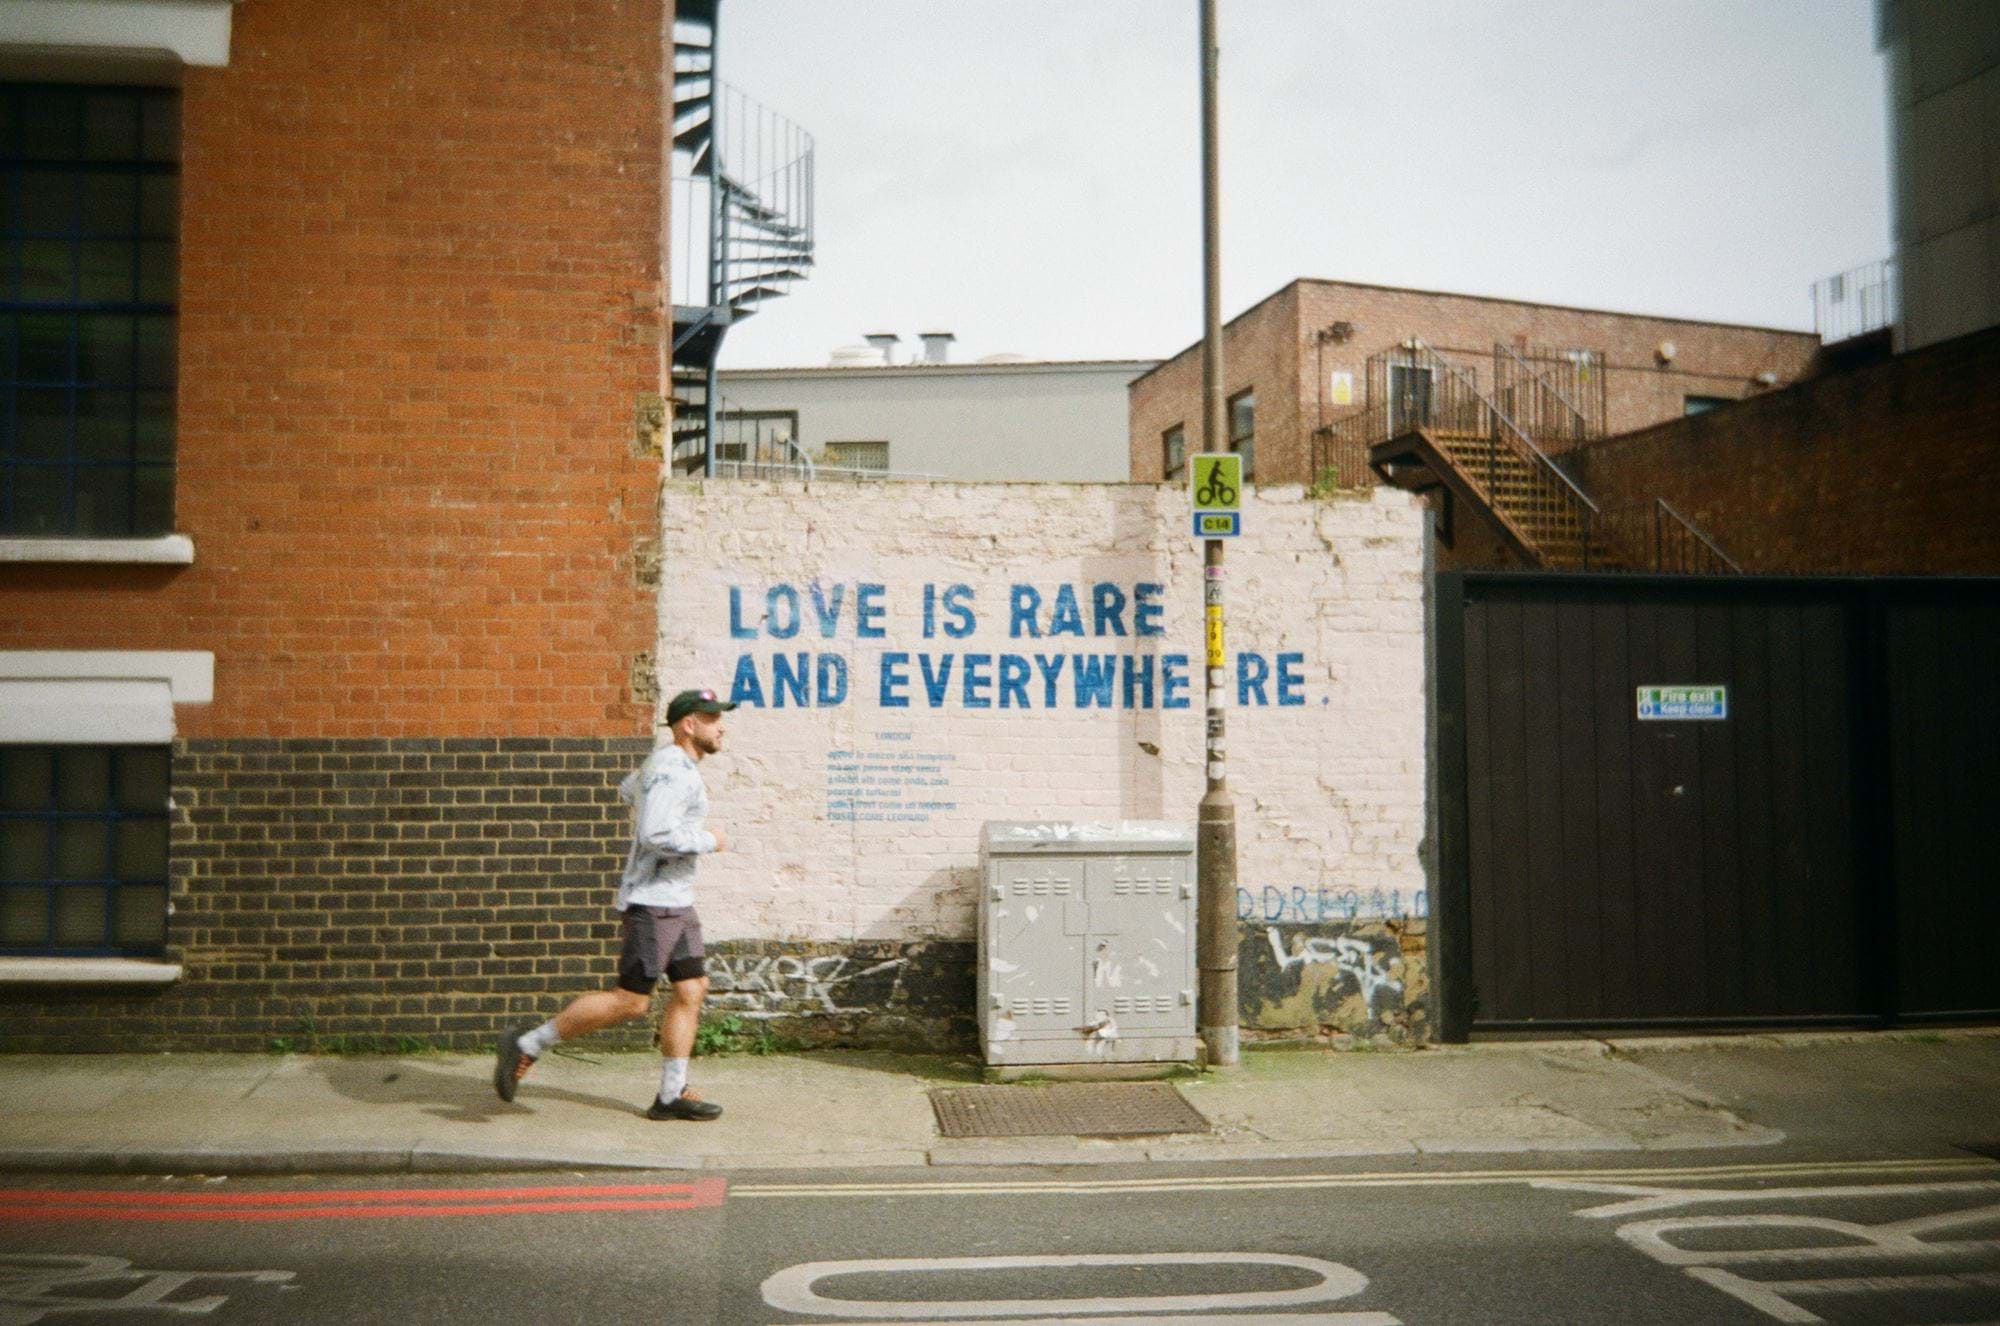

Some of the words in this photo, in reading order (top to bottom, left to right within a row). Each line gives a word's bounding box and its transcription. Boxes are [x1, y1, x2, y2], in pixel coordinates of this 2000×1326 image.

[1203, 518, 1229, 530] C14
[728, 584, 886, 640] LOVE
[921, 584, 977, 639] IS
[1007, 583, 1165, 638] RARE
[728, 652, 848, 708] AND
[1661, 688, 1686, 701] Fire
[1689, 688, 1713, 701] exit
[1661, 703, 1686, 714] Keep
[1689, 703, 1713, 714] clear
